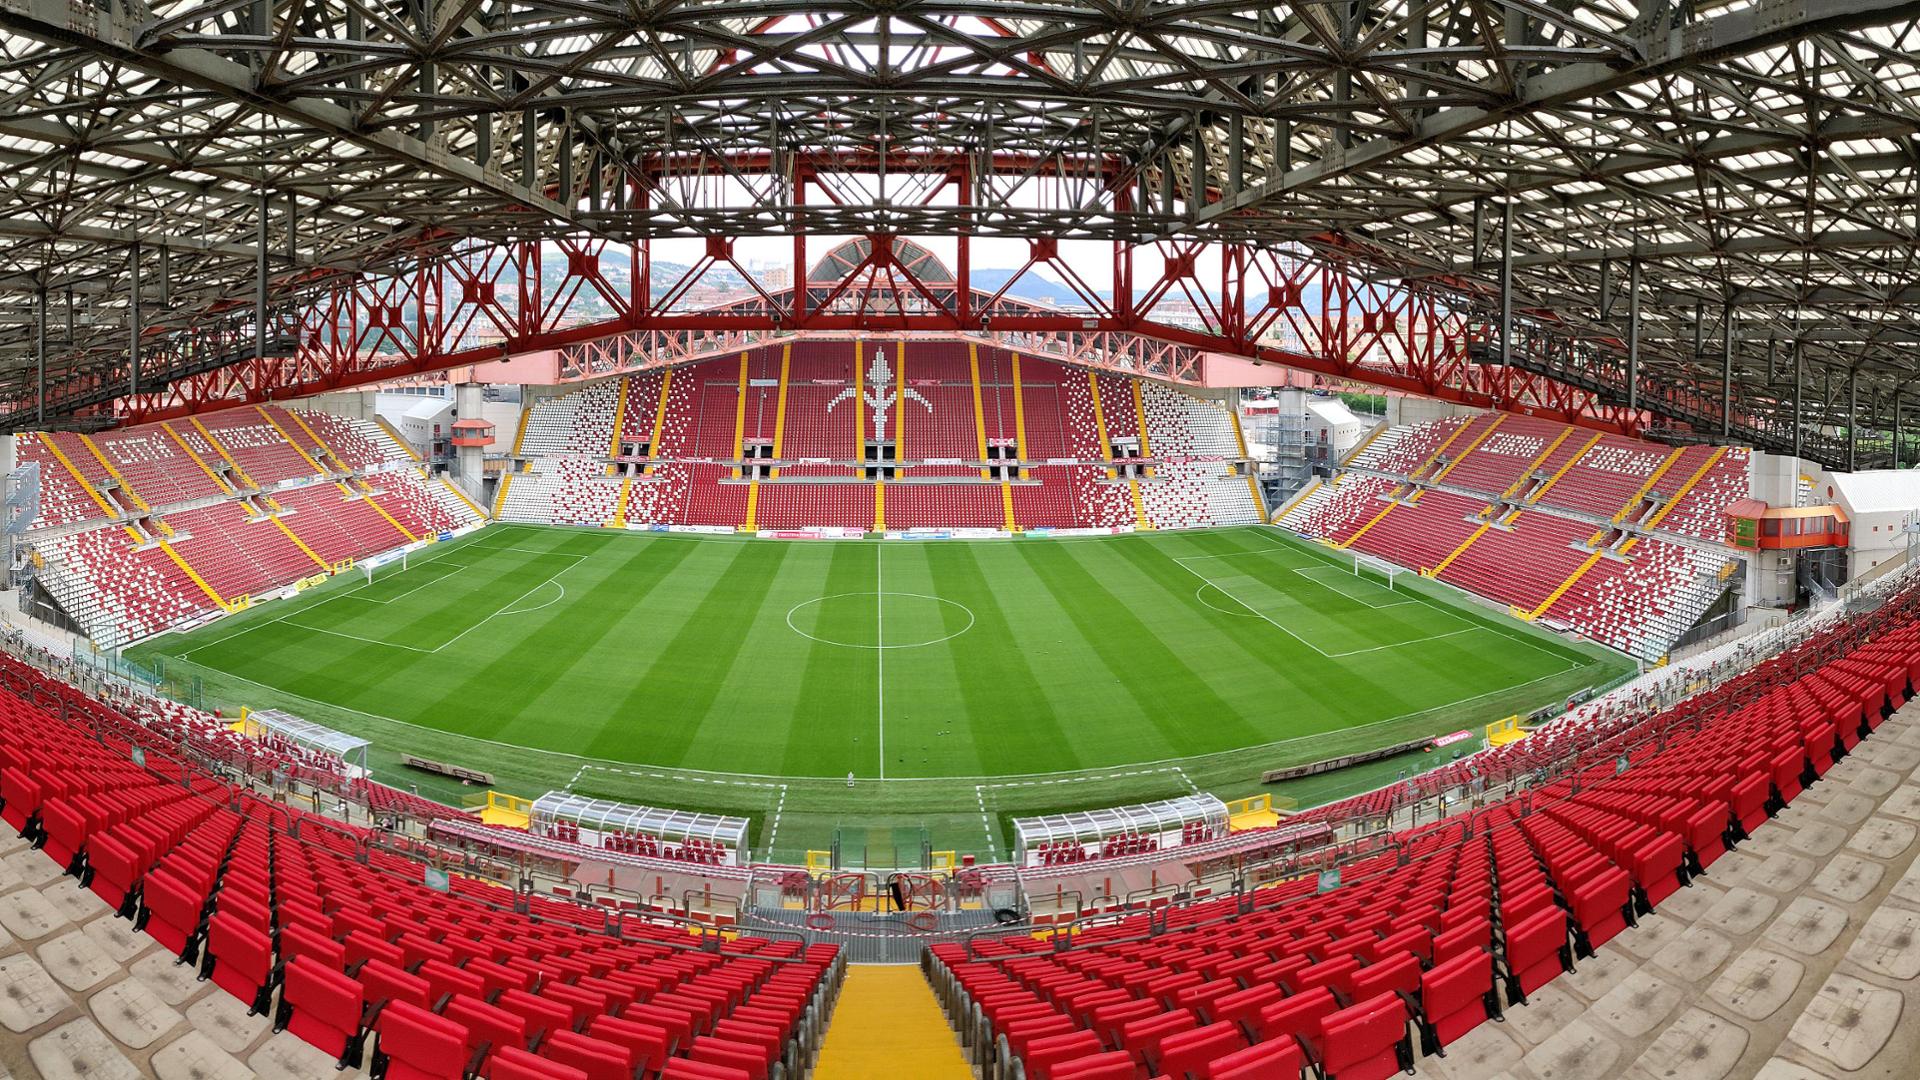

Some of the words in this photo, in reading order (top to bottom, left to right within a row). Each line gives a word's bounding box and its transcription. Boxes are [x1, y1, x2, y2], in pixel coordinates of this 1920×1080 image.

[209, 424, 289, 450] TRIESTE
[1480, 432, 1544, 458] CURVA
[1576, 444, 1666, 477] FURLAN
